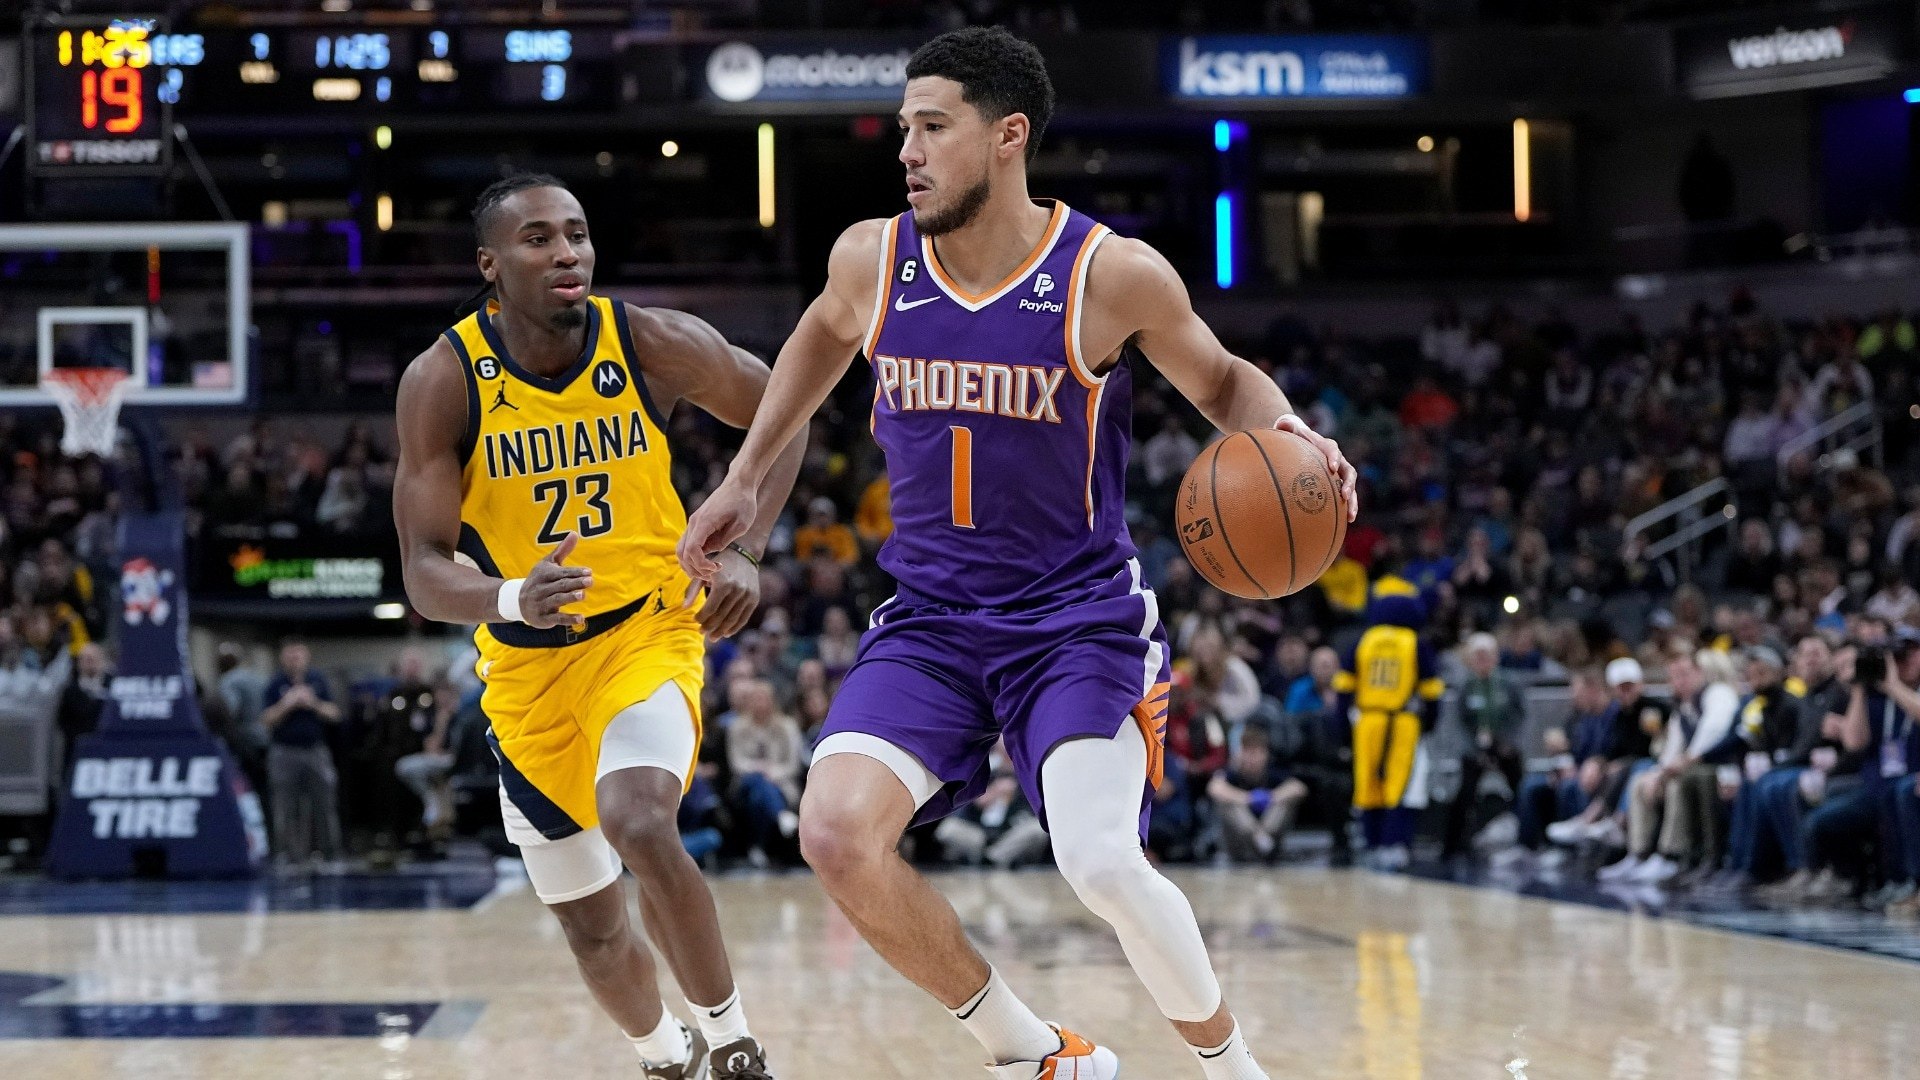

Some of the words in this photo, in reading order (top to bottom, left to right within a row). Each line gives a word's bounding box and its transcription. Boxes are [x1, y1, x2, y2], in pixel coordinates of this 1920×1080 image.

[1179, 37, 1304, 95] ksm
[1728, 26, 1844, 69] verizon
[81, 66, 143, 133] 19
[900, 260, 916, 283] 6
[1018, 299, 1063, 313] PayPal
[479, 358, 495, 379] 6
[875, 354, 1068, 424] PHOENIX
[484, 410, 649, 479] INDIANA
[949, 425, 976, 529] 1
[532, 472, 613, 546] 23
[72, 756, 222, 798] BELLE
[88, 798, 202, 839] TIRE
